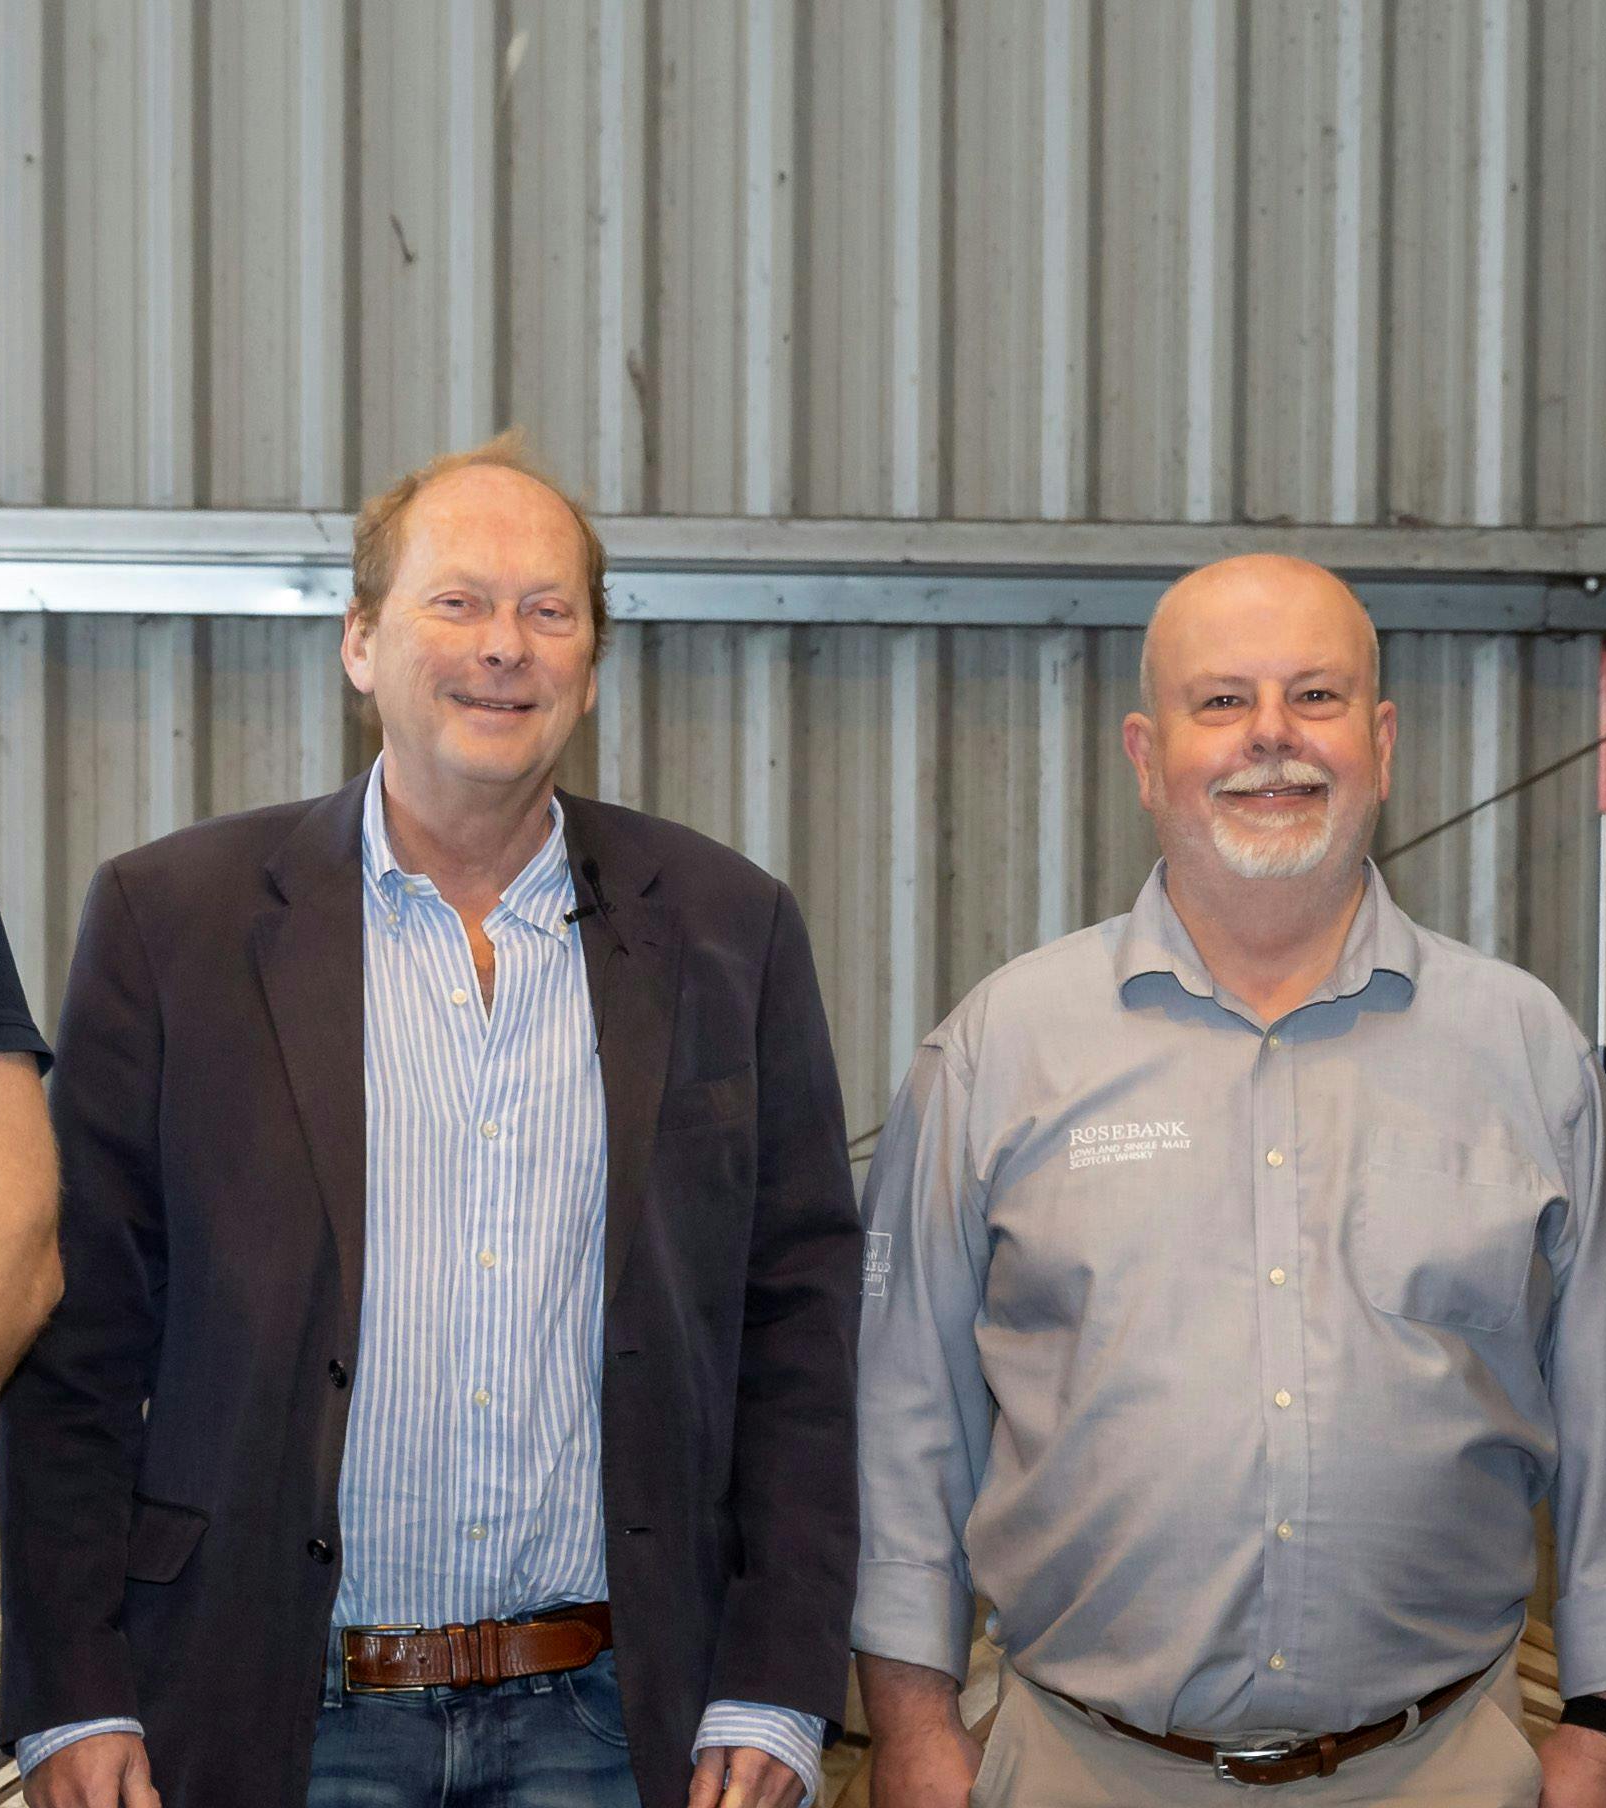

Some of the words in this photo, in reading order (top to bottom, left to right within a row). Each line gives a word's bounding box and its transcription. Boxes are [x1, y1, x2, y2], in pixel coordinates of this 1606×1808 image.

[1069, 1122, 1188, 1146] ROSEBANK
[1069, 1143, 1121, 1160] LOWLAND
[1123, 1140, 1158, 1152] SINGLE
[1162, 1140, 1191, 1149] MALT
[1069, 1153, 1111, 1170] SCOTCH
[1115, 1151, 1153, 1161] WHISKY
